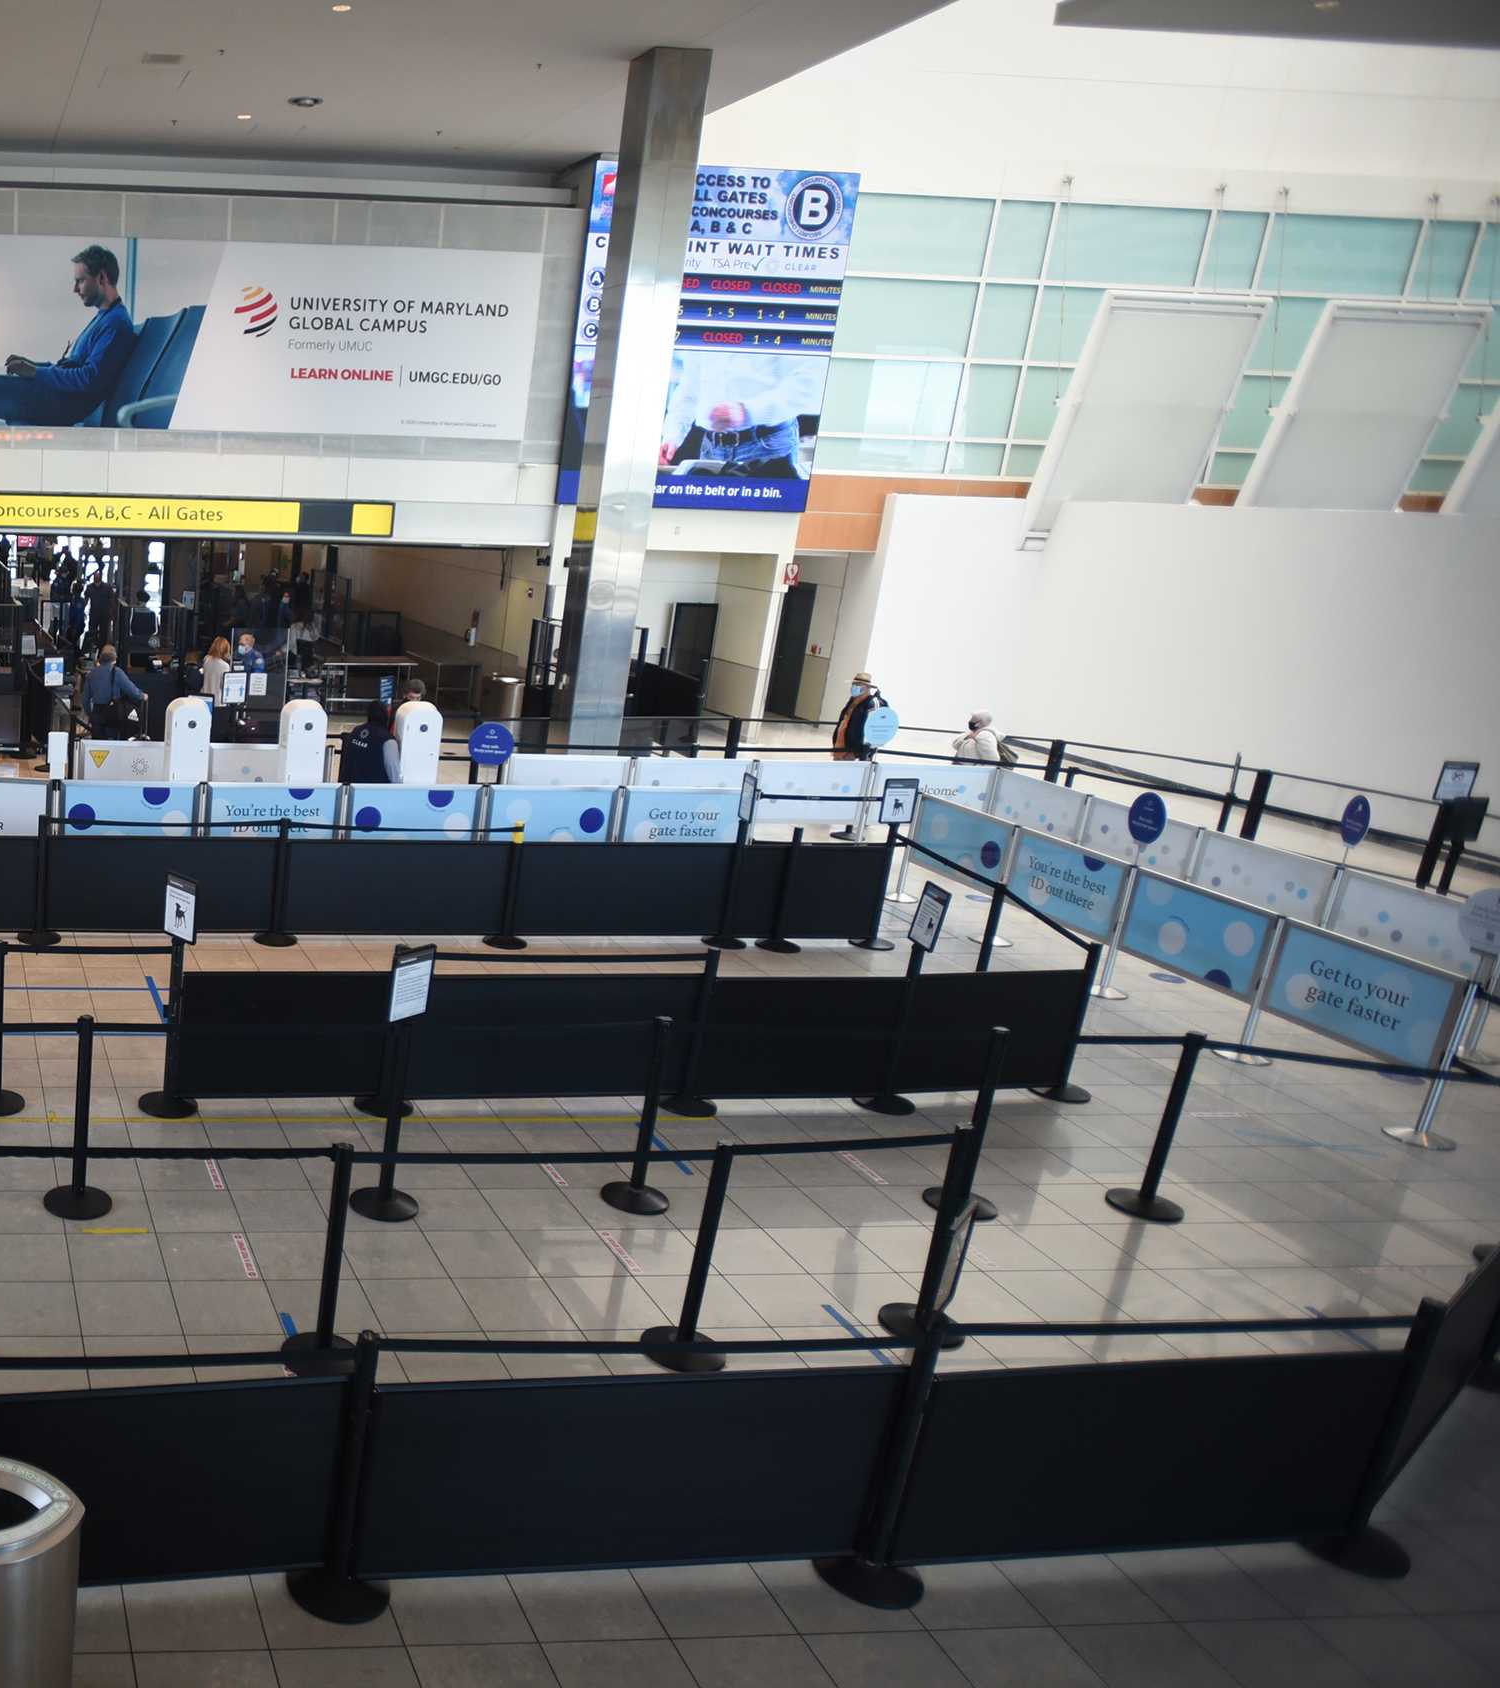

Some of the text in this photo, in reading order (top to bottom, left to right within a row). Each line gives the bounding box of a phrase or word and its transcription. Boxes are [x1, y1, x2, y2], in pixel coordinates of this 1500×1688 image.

[695, 173, 771, 189] CCESS TO
[694, 189, 768, 204] LL GATES
[691, 206, 779, 220] CONCOURSES
[800, 189, 829, 225] B
[690, 220, 753, 234] A, B & C
[595, 236, 606, 247] C
[687, 241, 840, 260] INT WAIT TIMES
[684, 258, 701, 270] rity
[712, 258, 730, 269] TSA
[784, 263, 817, 271] CLEAR
[711, 279, 751, 291] CLOSED
[761, 282, 802, 294] CLOSED
[810, 285, 841, 294] MINUTES
[290, 297, 509, 317] UNIVERSITY OF MARYLAND
[727, 307, 734, 318] 5
[778, 310, 785, 320] 4
[805, 312, 836, 321] MINUTES
[289, 317, 427, 333] GLOBAL CAMPUS
[288, 338, 372, 352] Formerly UMUC
[703, 332, 743, 344] CLOSED
[774, 336, 781, 345] 4
[801, 337, 832, 346] MINUTES
[291, 368, 394, 381] LEARN ONLINE
[409, 371, 502, 386] UMGC.EDU/GO
[669, 485, 683, 494] on
[685, 485, 703, 495] the
[705, 485, 725, 496] belt
[727, 487, 740, 496] or
[741, 486, 752, 497] in
[753, 488, 761, 497] a
[762, 487, 782, 498] bin.
[86, 505, 132, 521] A,B,C
[149, 506, 170, 521] All
[176, 507, 224, 521] Gates
[921, 784, 959, 797] lcome
[225, 804, 320, 817] You're the best
[649, 808, 720, 823] Get to your
[277, 823, 309, 833] tere
[649, 824, 716, 840] gate faster
[1029, 856, 1106, 896] You're the best
[1030, 876, 1094, 910] ID out there
[1310, 960, 1410, 1008] Get to your
[1304, 986, 1401, 1030] gate faster
